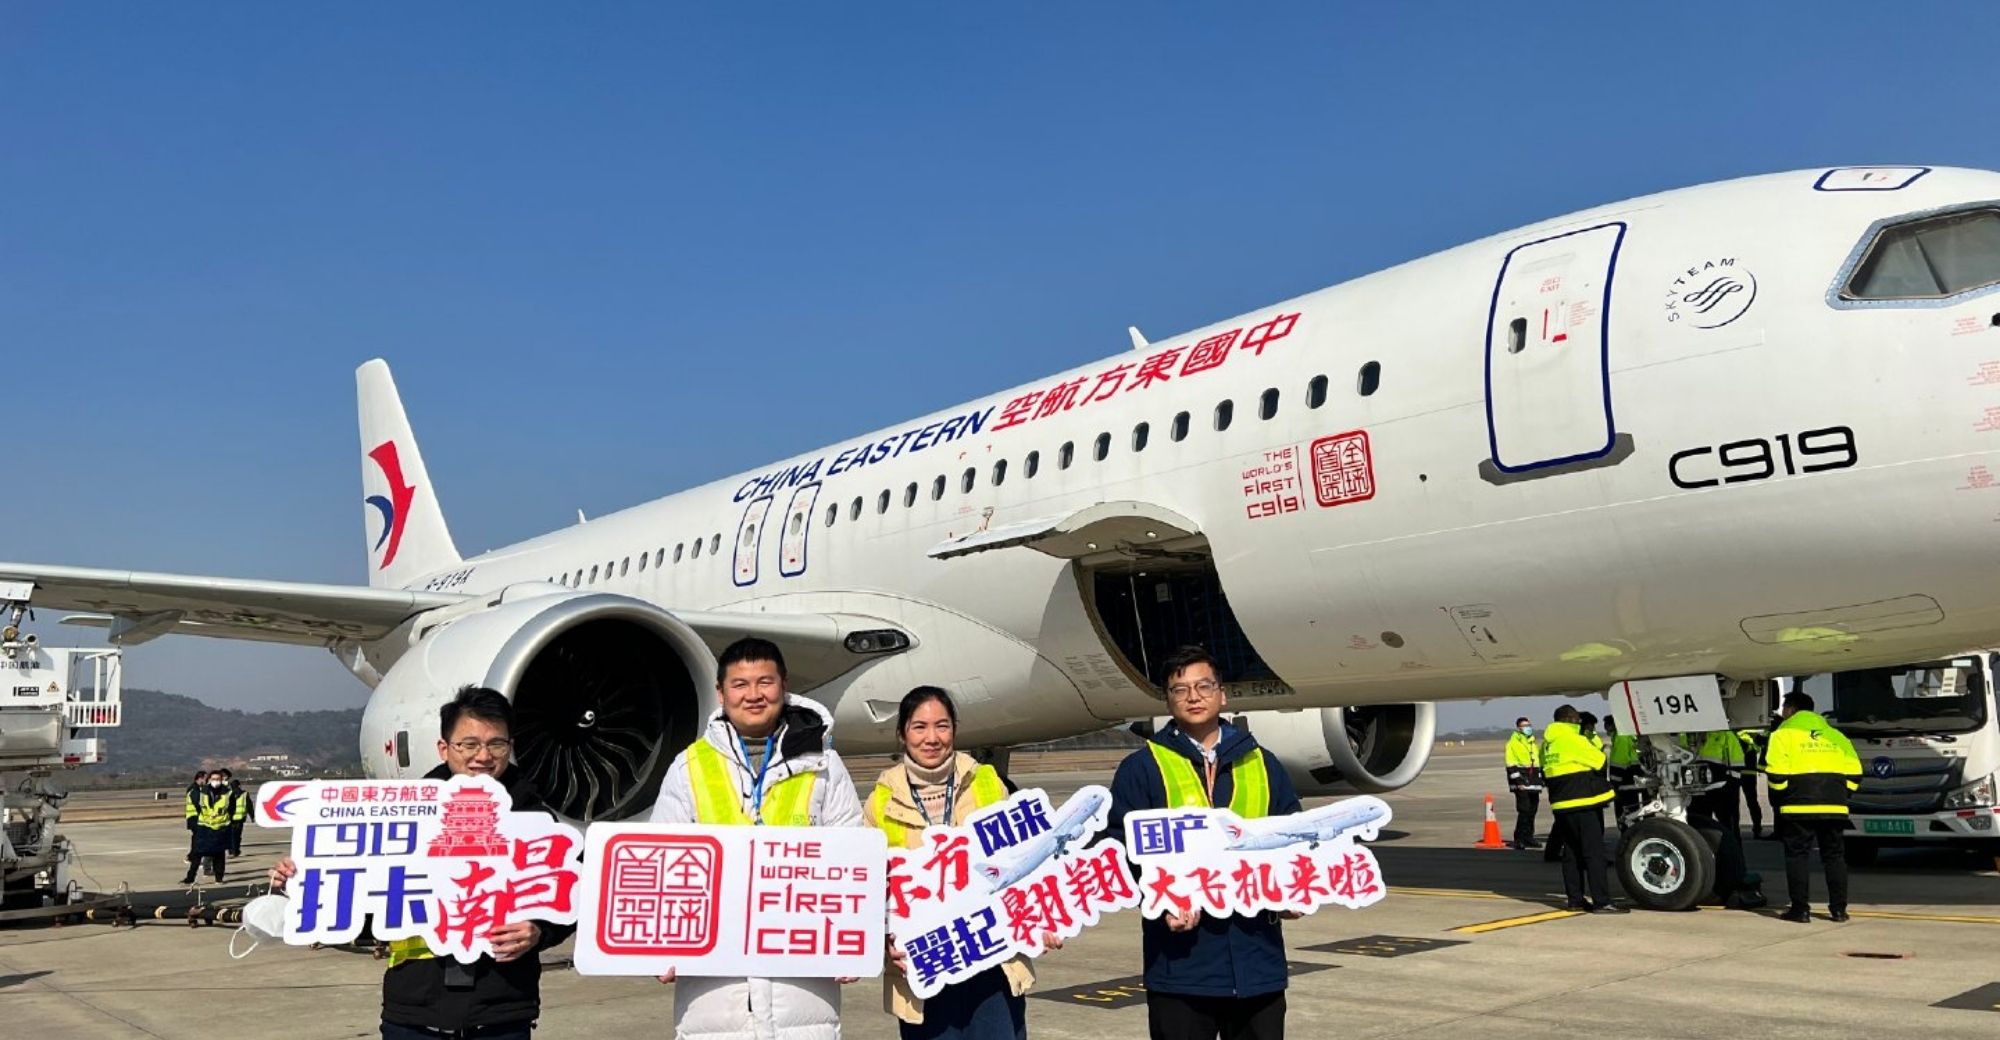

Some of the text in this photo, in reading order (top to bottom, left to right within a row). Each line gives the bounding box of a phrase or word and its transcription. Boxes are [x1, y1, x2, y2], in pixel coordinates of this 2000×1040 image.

[1665, 258, 1735, 322] SKYTEAM
[733, 406, 996, 502] CHINA EASTERN
[1264, 448, 1292, 462] THE
[1669, 425, 1857, 489] C919
[1242, 462, 1292, 479] WORLD'S
[1244, 477, 1294, 496] FIRST
[1246, 494, 1299, 519] C919
[1653, 694, 1698, 715] 19A
[321, 786, 438, 802] 中國東方航空
[320, 805, 437, 818] CHINA EASTERN
[305, 821, 418, 858] C919
[1133, 814, 1208, 855] 国产
[764, 842, 821, 858] THE
[761, 866, 867, 881] WORLD'S
[1148, 854, 1378, 911] 大飞机来啦
[759, 883, 866, 913] FIRST
[757, 917, 865, 955] C919
